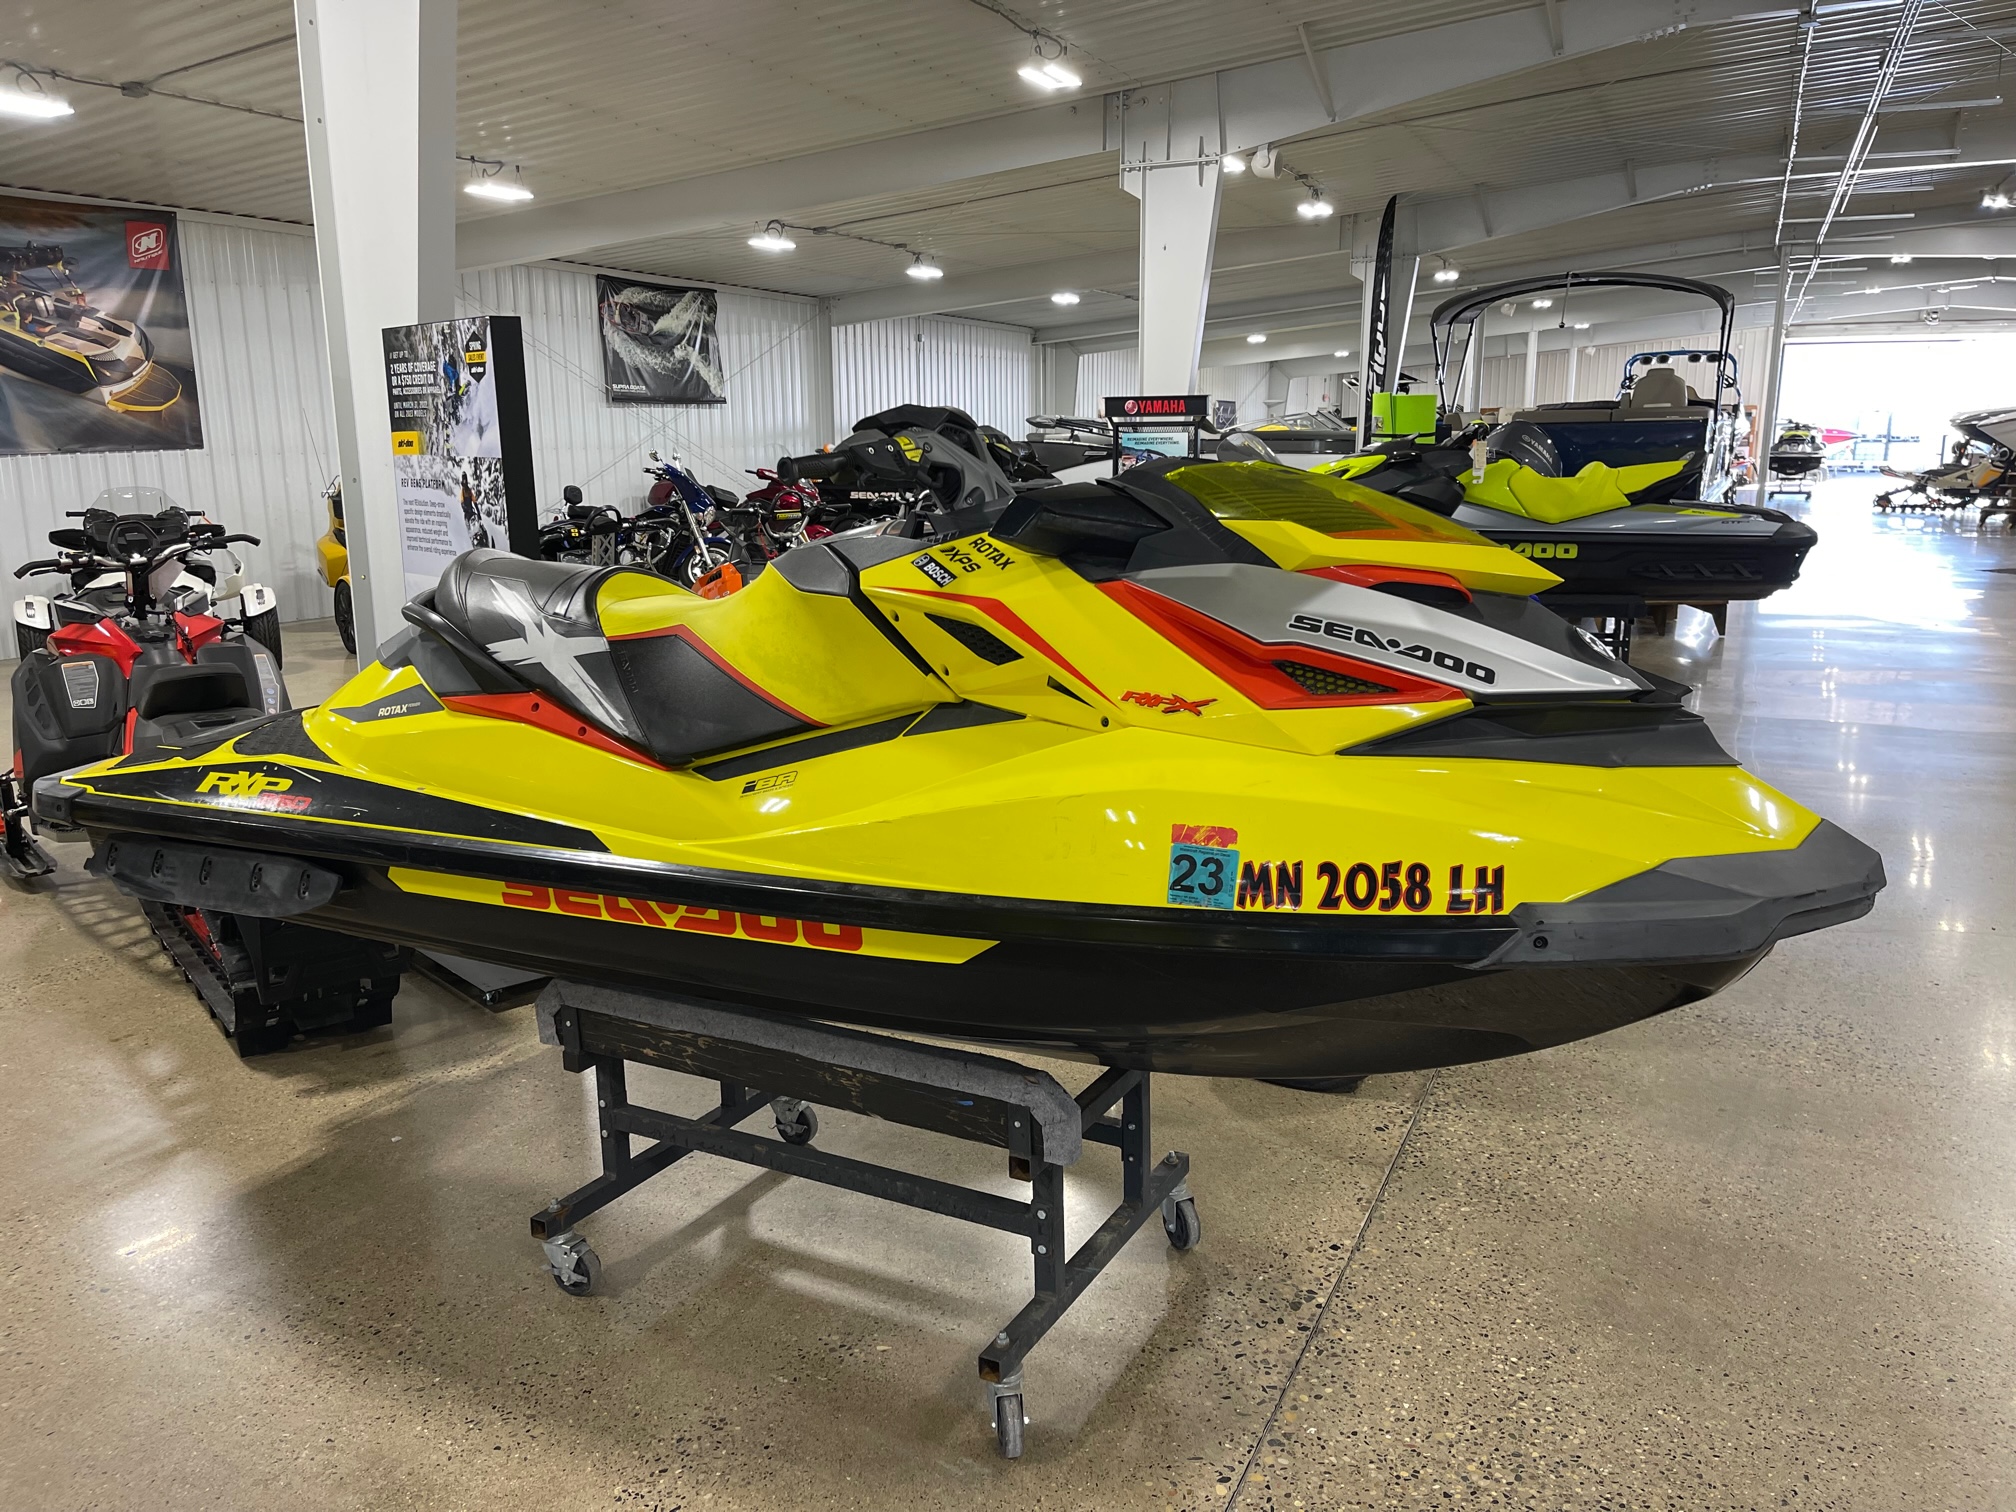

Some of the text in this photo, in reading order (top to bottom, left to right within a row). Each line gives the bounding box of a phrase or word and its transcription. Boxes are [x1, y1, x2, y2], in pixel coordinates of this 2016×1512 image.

[394, 362, 407, 374] YEARS
[408, 362, 413, 372] OF
[414, 361, 436, 372] COVERAGE
[412, 374, 427, 385] CREDIT
[1138, 399, 1186, 414] YAMAHA
[1530, 438, 1552, 464] YAMAHA
[941, 546, 982, 573] XPS
[968, 536, 1016, 571] ROTAX
[923, 562, 954, 586] BOSCH
[378, 704, 408, 717] ROTAX
[195, 770, 294, 800] RXP
[1170, 854, 1224, 896] 23
[1236, 860, 1303, 911] MN
[1316, 860, 1432, 912] 2058
[1446, 864, 1504, 914] LH
